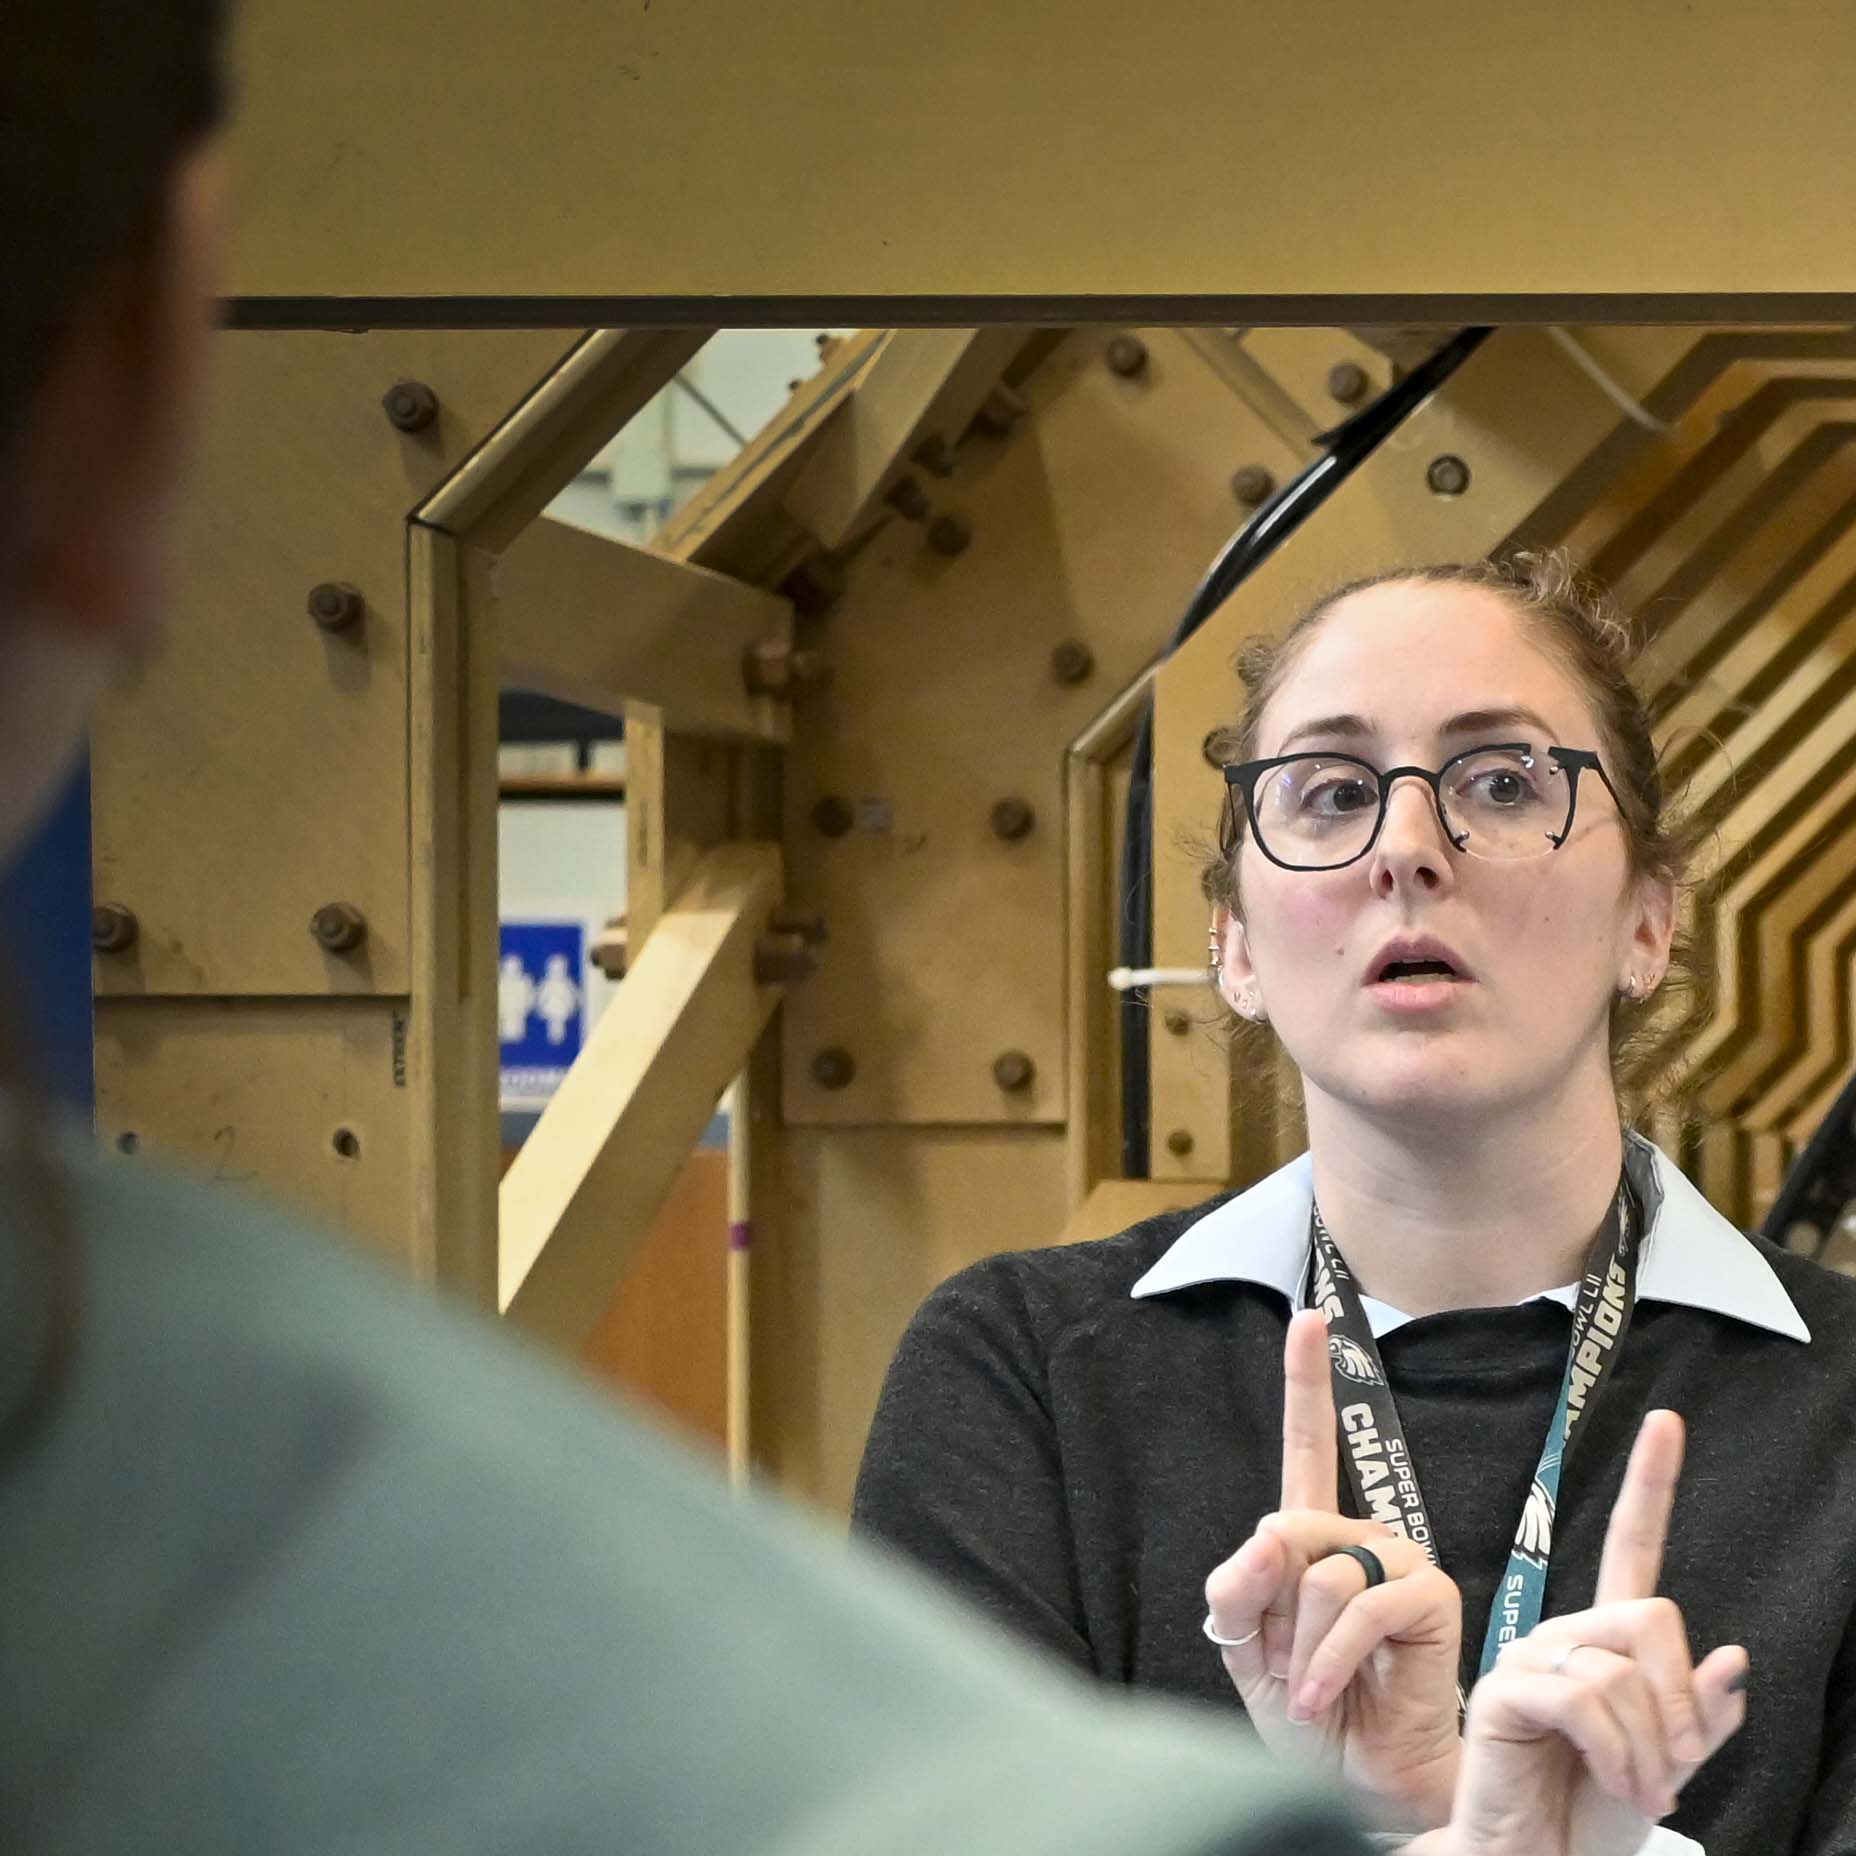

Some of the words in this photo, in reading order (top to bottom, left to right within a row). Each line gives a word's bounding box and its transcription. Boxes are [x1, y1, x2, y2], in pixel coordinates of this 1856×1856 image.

[1570, 1303, 1595, 1359] OWL
[1385, 1438, 1420, 1508] SUPER
[1498, 1574, 1524, 1648] SUPE
